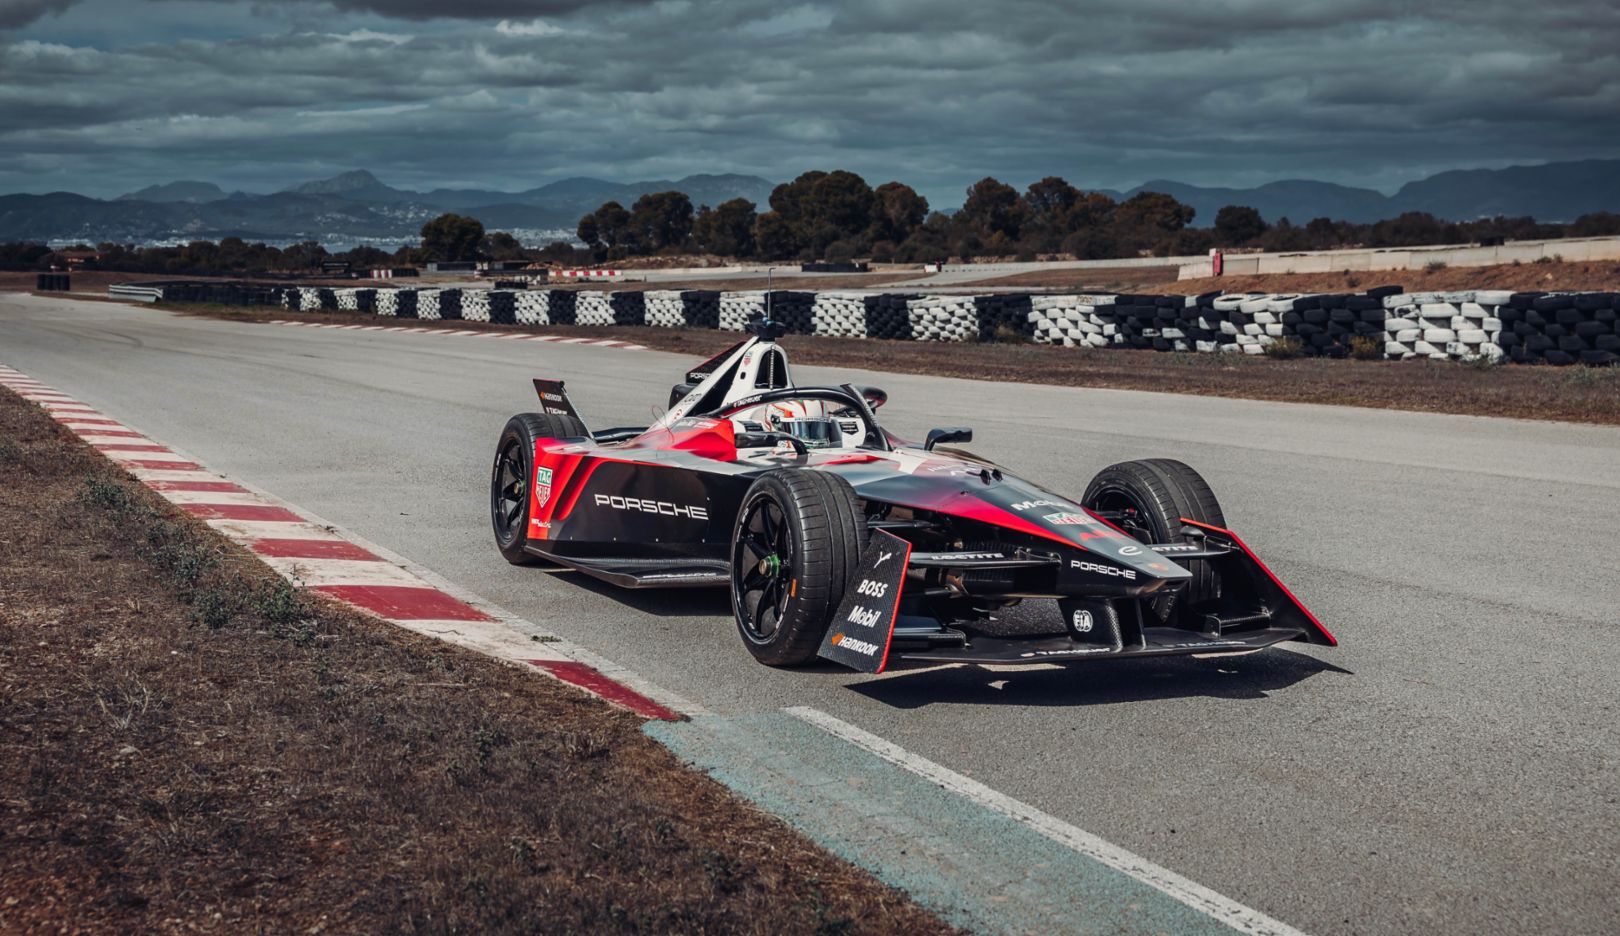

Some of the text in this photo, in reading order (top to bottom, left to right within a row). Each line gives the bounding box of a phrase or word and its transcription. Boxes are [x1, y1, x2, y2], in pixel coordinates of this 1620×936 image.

[594, 494, 709, 520] PORSCHE
[1071, 560, 1136, 580] PORSCHE
[857, 579, 889, 598] BOSS
[847, 605, 882, 628] Mobil
